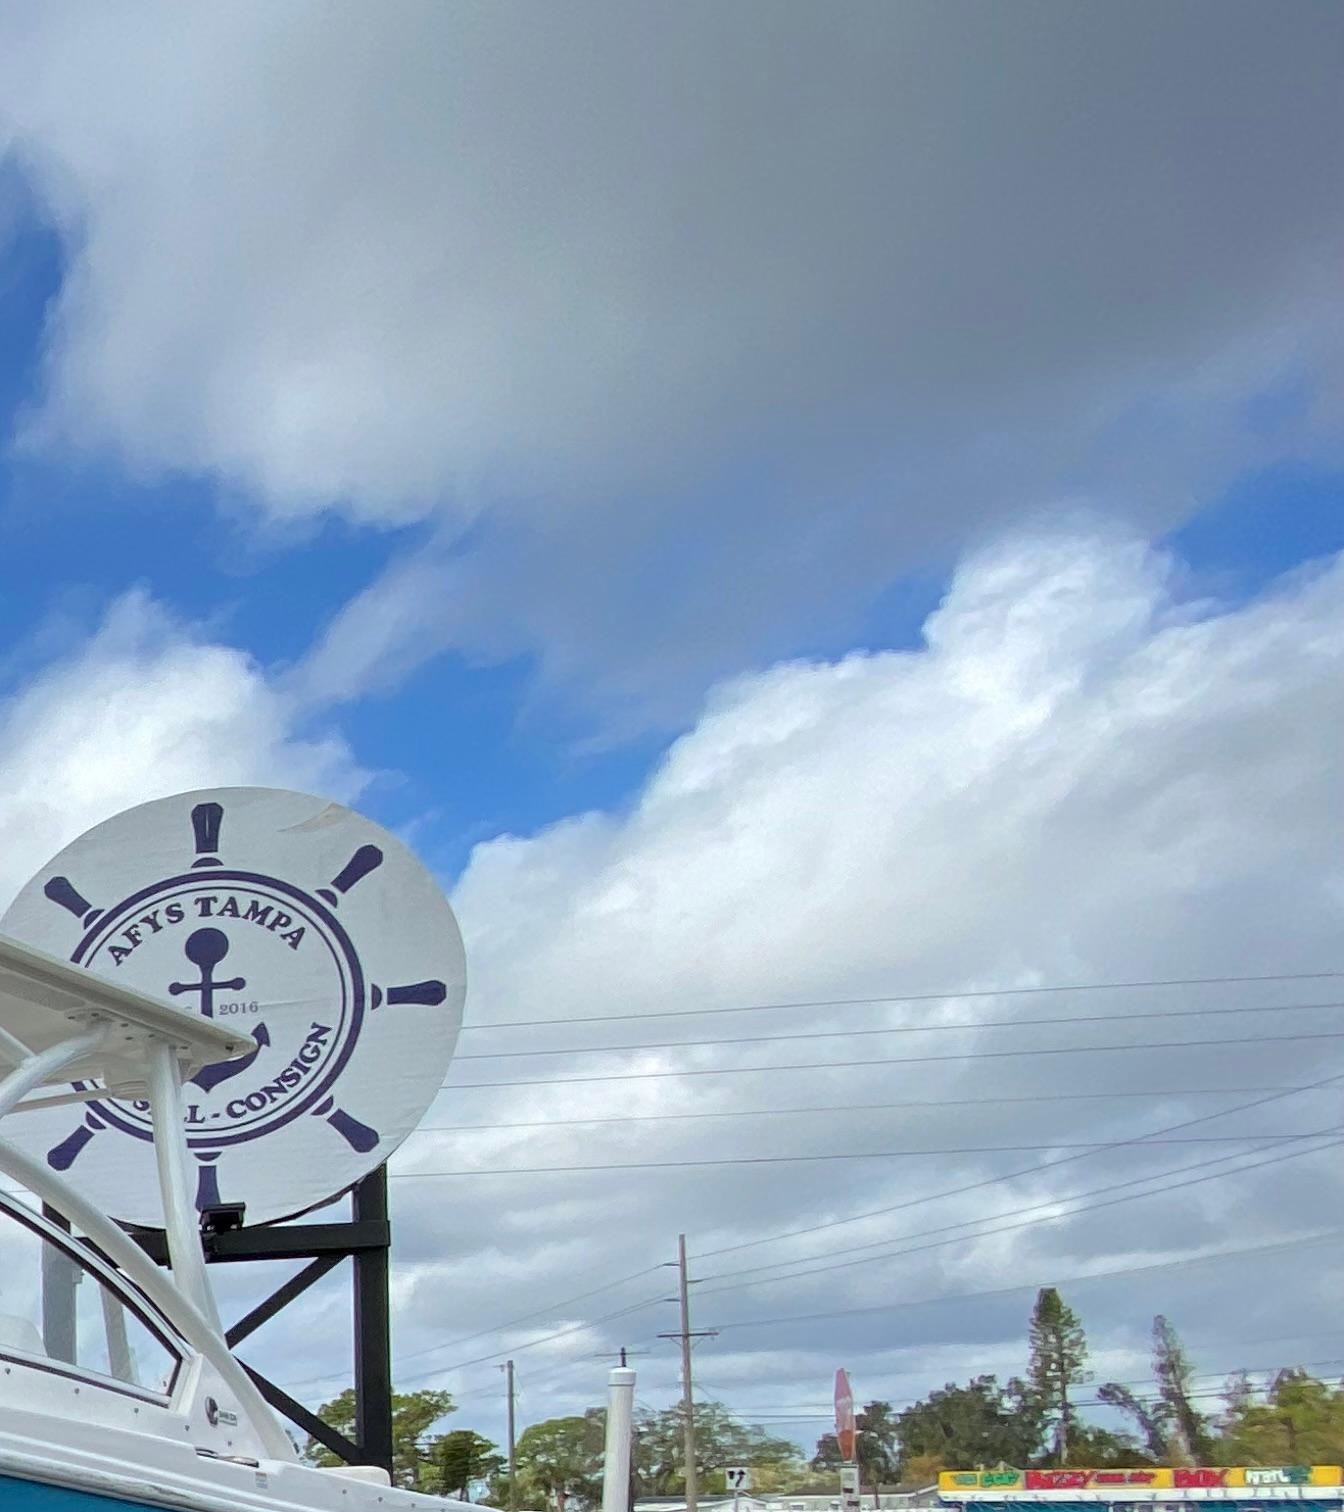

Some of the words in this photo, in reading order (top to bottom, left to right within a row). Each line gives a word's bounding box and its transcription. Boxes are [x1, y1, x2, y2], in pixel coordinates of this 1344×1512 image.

[107, 902, 185, 966] AFYS
[194, 896, 306, 950] TAMPA
[218, 1001, 259, 1016] 2016
[226, 1022, 333, 1118] CONSIGN
